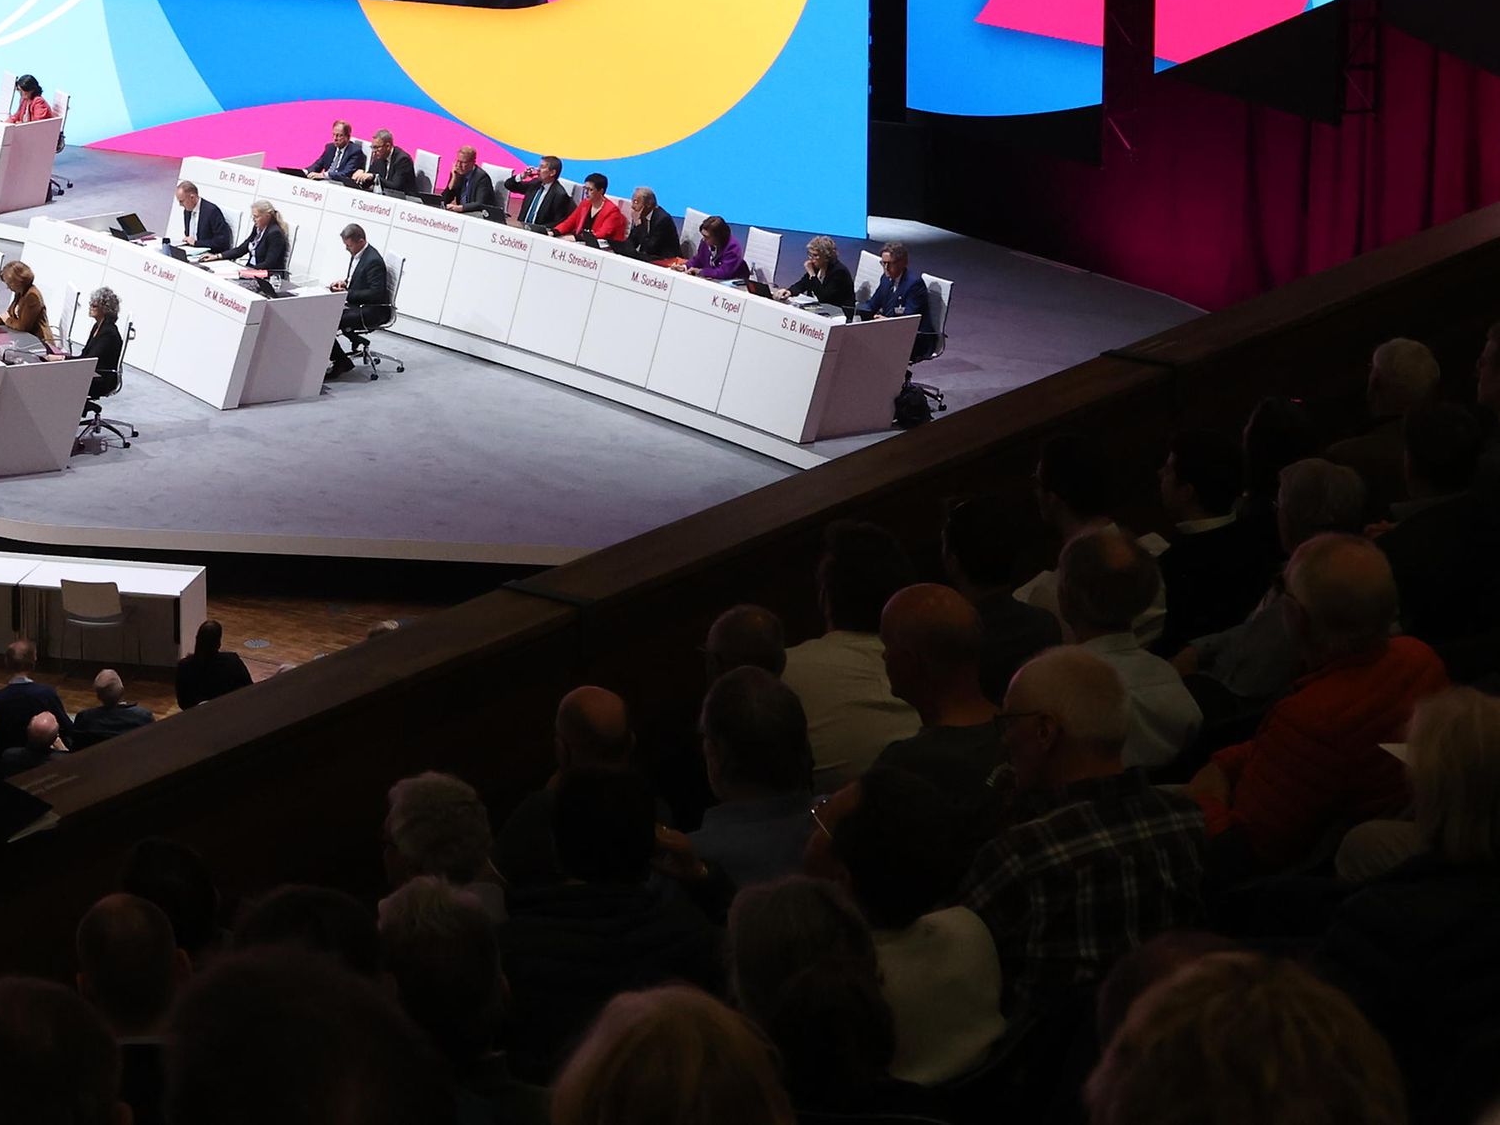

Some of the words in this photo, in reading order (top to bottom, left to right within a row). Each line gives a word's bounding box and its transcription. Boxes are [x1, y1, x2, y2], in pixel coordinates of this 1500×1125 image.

[219, 170, 229, 182] Dr.
[229, 173, 237, 183] R.
[238, 174, 256, 187] Ploss
[291, 185, 299, 196] S.
[300, 187, 323, 203] Ramge
[351, 199, 357, 209] F.
[358, 200, 392, 217] Sauerland
[400, 210, 407, 221] C.
[64, 234, 72, 245] Dr.
[72, 237, 79, 247] C.
[491, 233, 498, 244] S.
[143, 261, 151, 273] Dr.
[158, 267, 176, 281] Junker
[568, 254, 598, 271] Streibich
[631, 271, 640, 283] M.
[640, 274, 668, 292] Suckale
[204, 286, 212, 298] Dr.
[212, 289, 219, 301] M.
[711, 294, 719, 307] K.
[721, 297, 741, 314] Topel
[781, 317, 789, 330] S.
[790, 319, 798, 333] B.
[799, 322, 825, 342] Wintels
